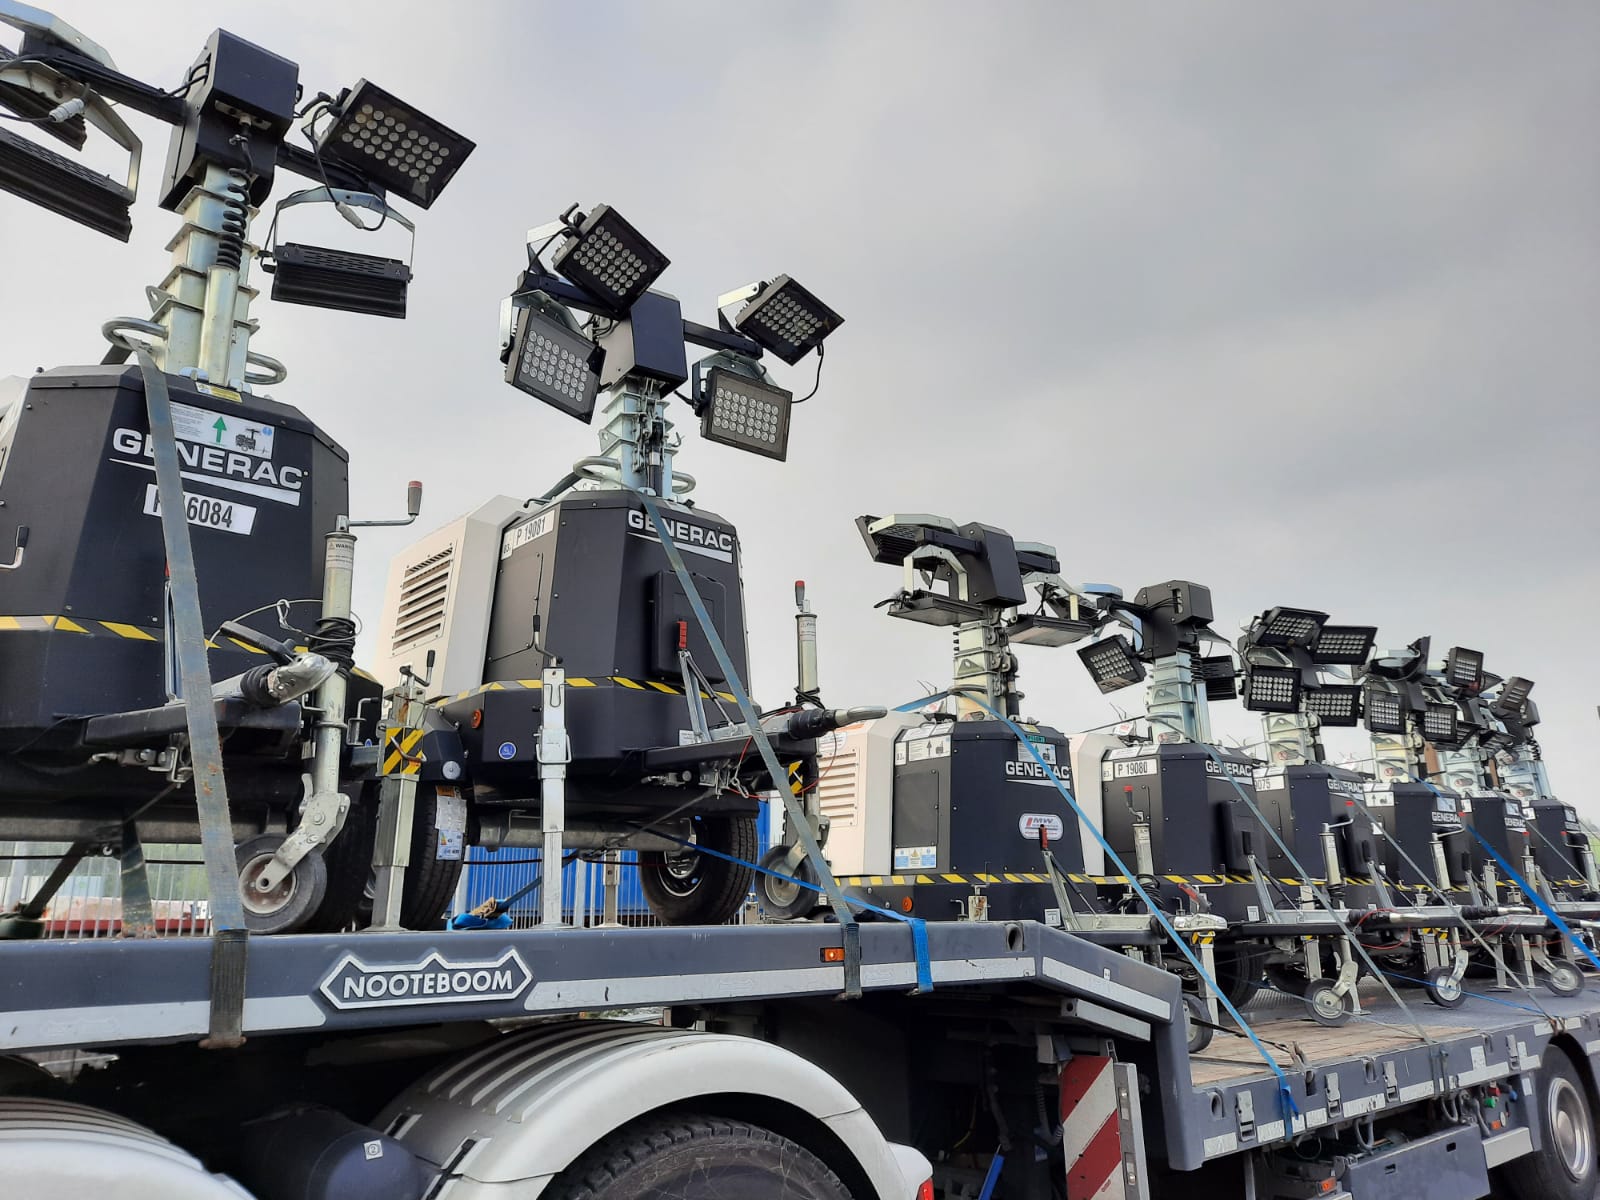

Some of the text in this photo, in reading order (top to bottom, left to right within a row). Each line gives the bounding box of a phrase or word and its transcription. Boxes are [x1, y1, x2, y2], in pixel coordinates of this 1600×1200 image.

[516, 516, 546, 546] P 19081
[1118, 764, 1124, 776] P
[1126, 761, 1148, 775] 19080
[343, 970, 513, 998] NOOTEBOOM
